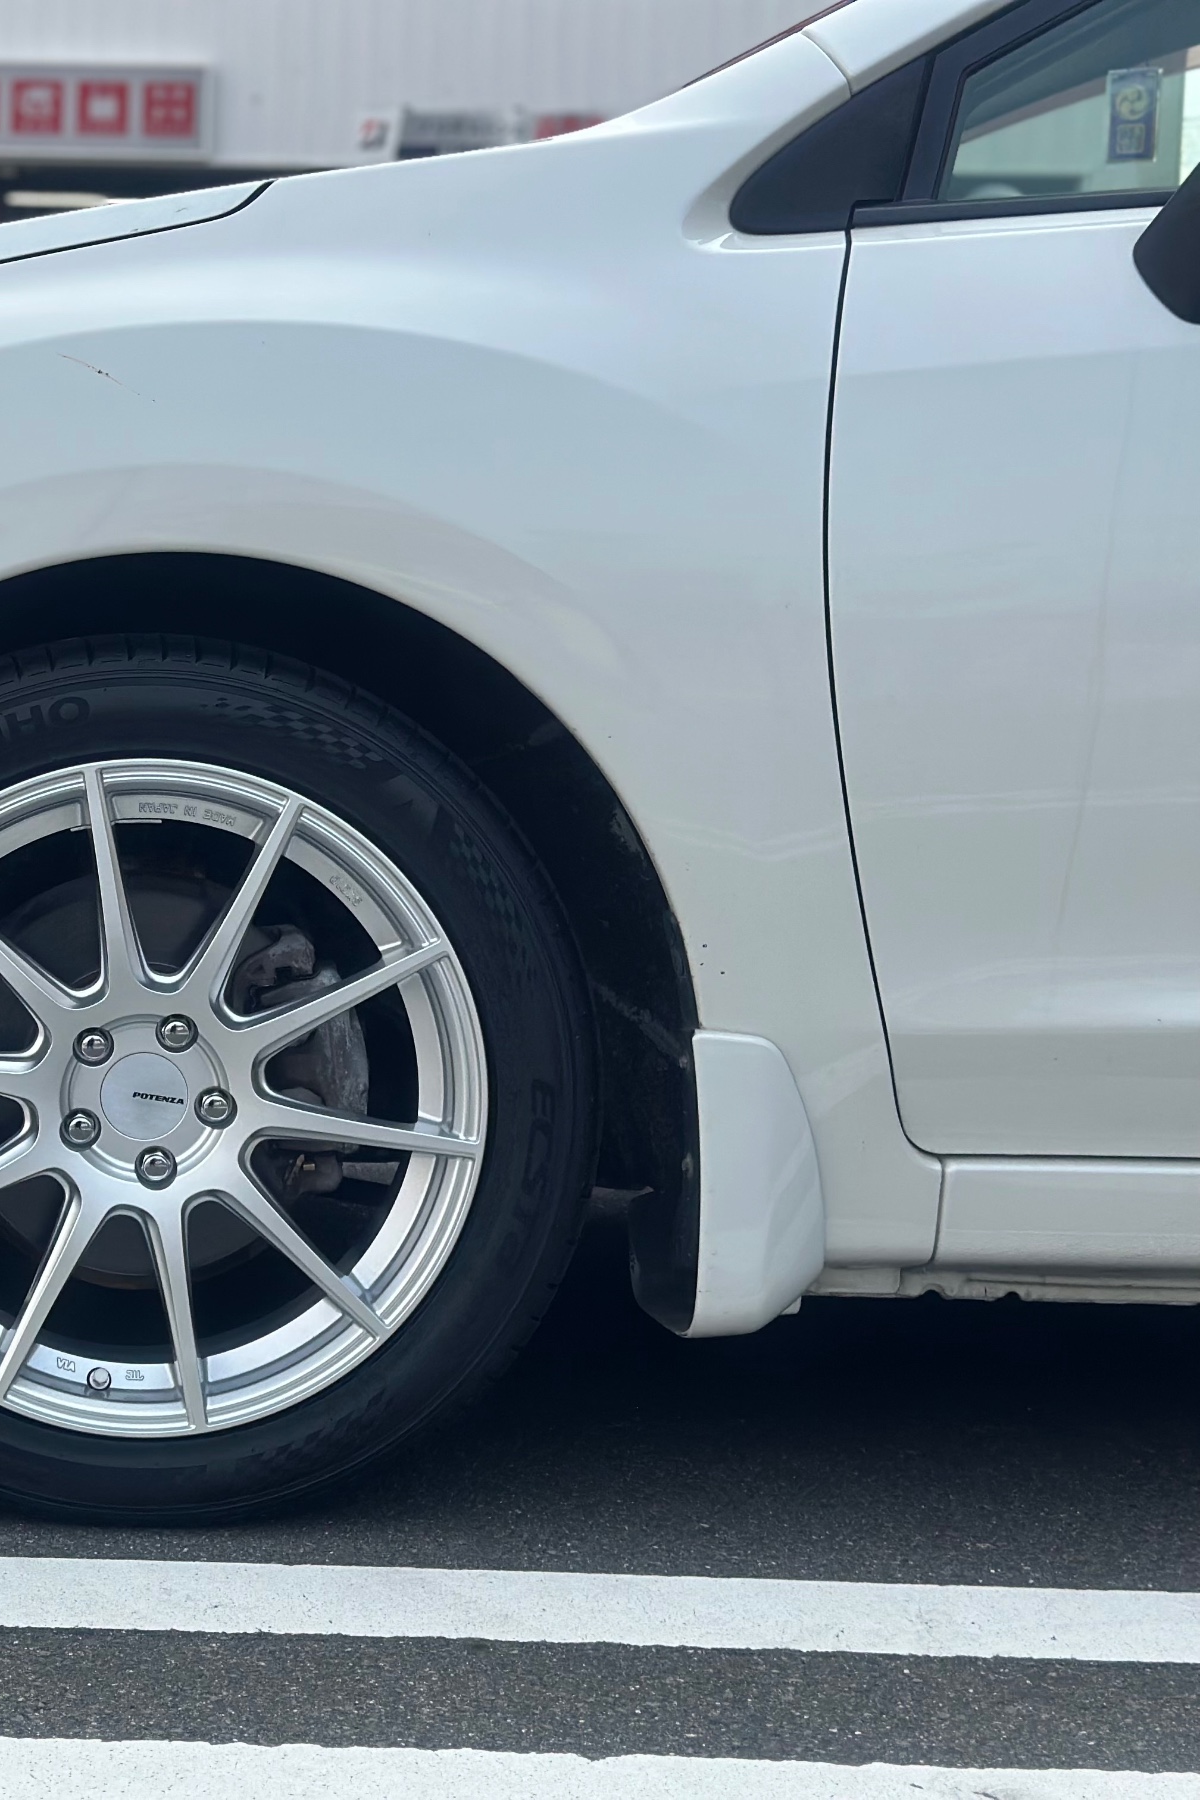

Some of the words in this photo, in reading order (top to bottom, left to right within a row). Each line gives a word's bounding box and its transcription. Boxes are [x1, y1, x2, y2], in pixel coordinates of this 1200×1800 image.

[138, 801, 179, 814] JAPAN
[183, 804, 198, 818] IN
[202, 808, 237, 827] MADE
[132, 1091, 184, 1105] POTENZA
[56, 1356, 76, 1373] VIA
